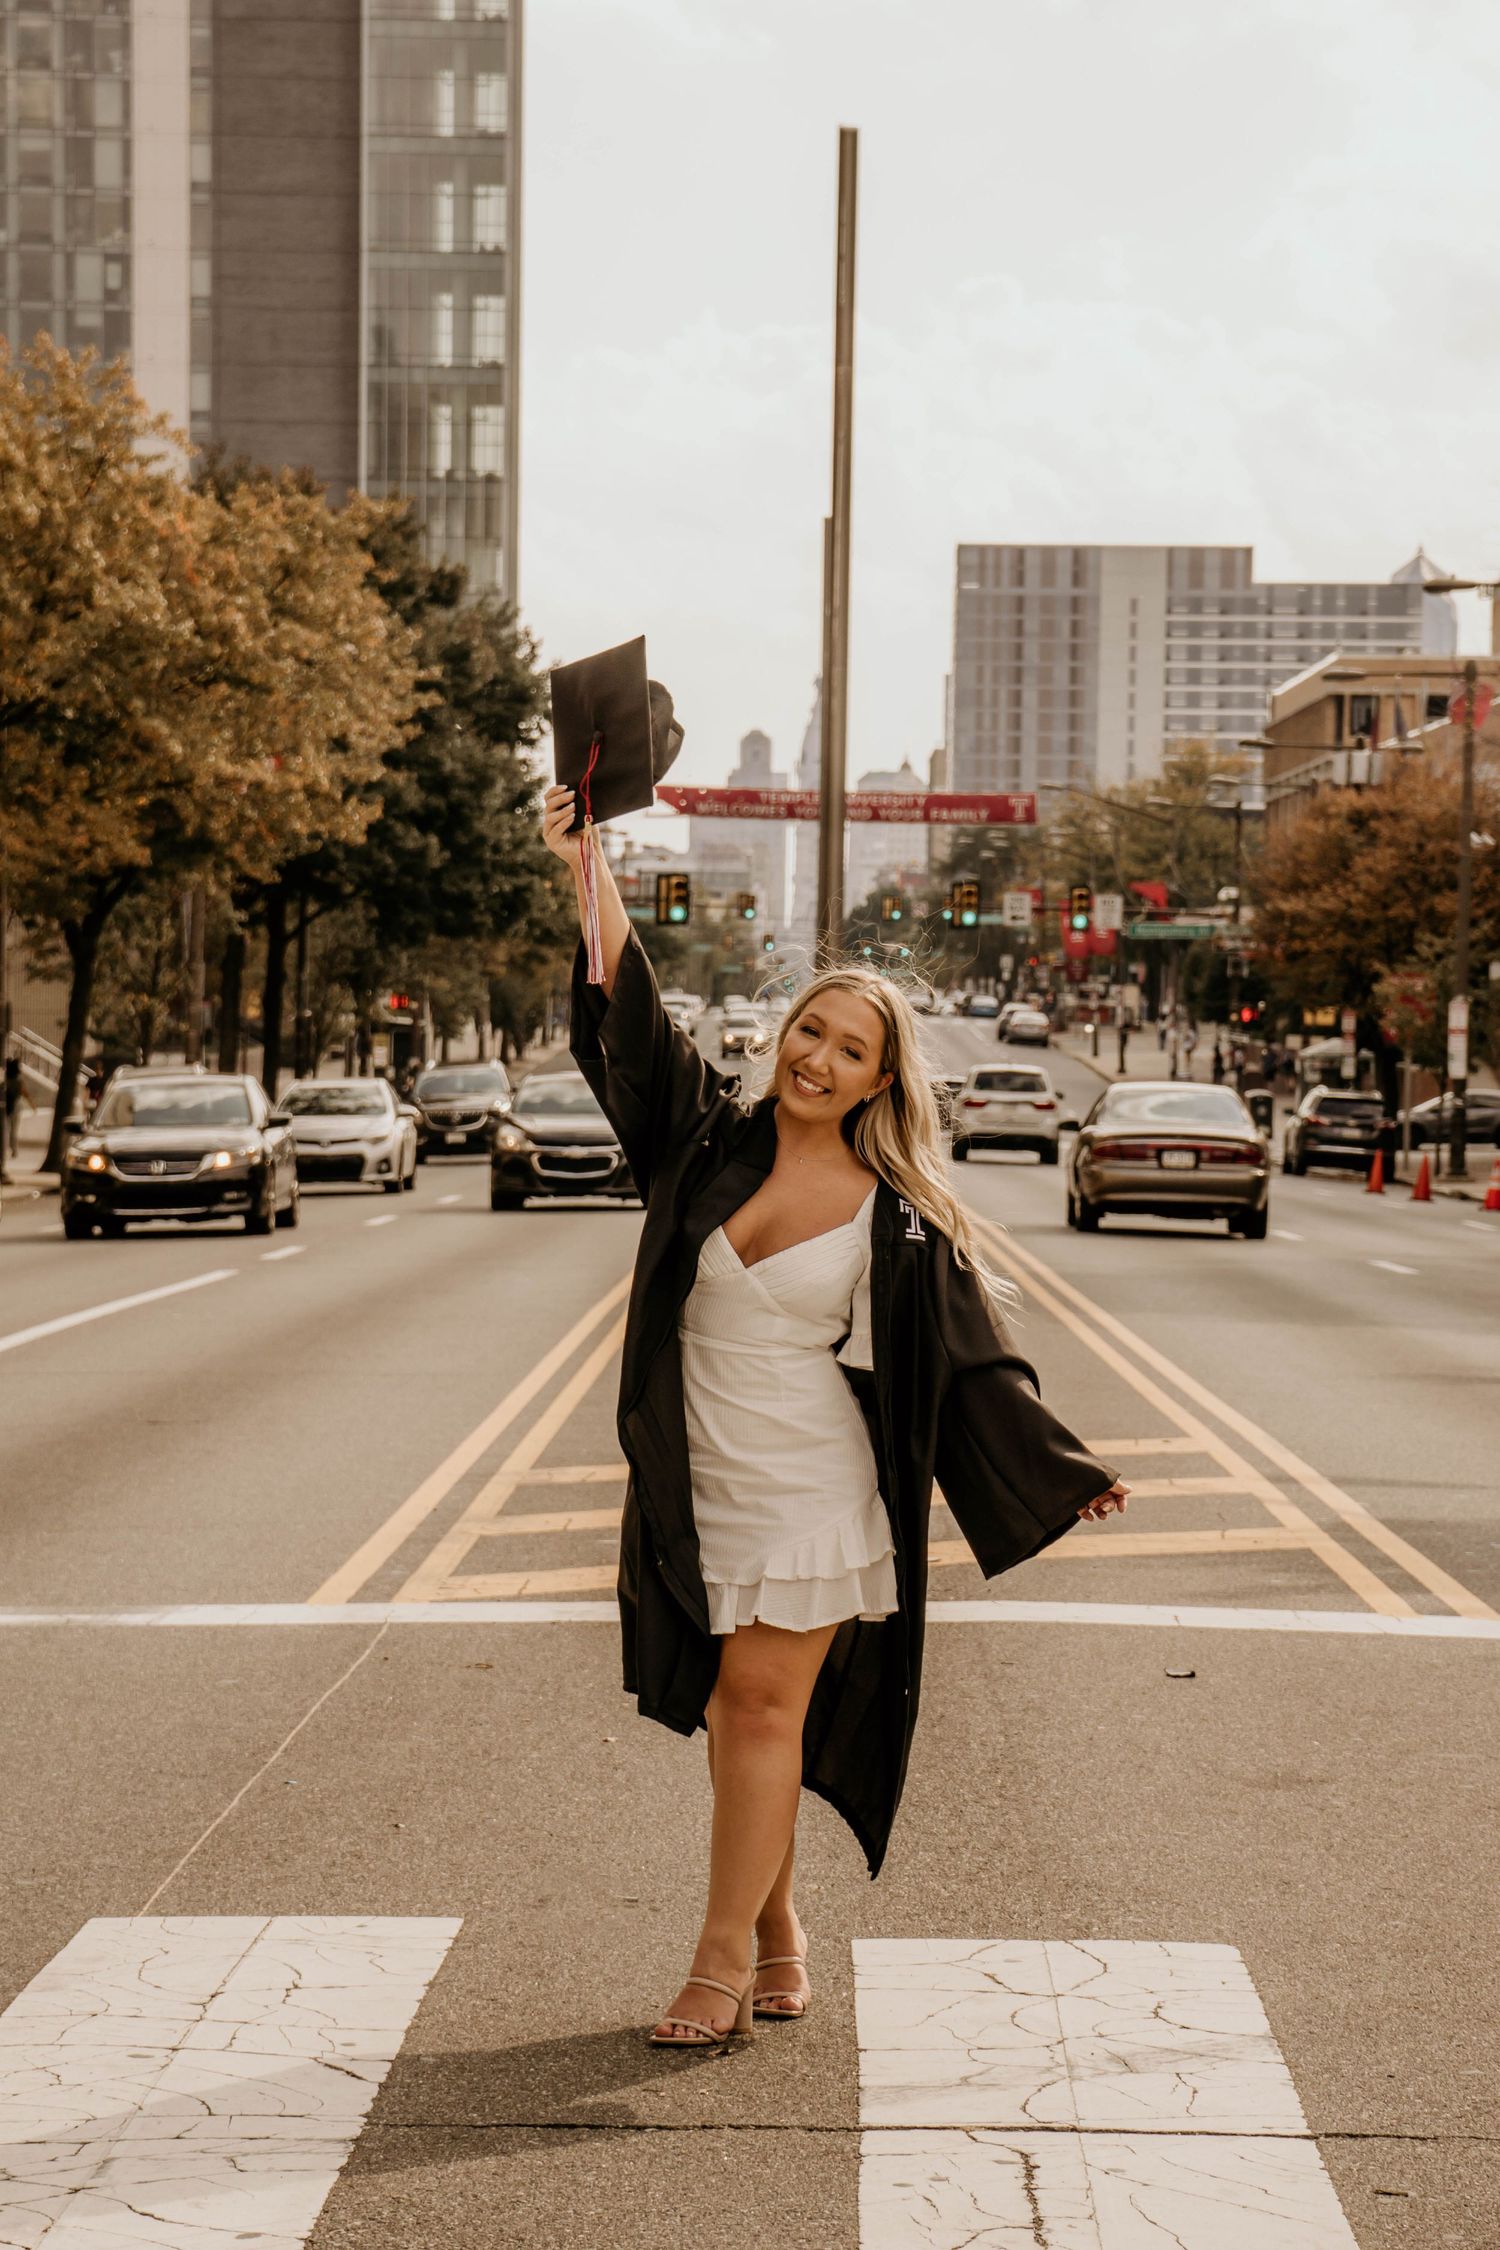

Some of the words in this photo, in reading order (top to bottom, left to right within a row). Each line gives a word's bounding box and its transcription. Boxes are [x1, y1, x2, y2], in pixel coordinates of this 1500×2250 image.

[695, 801, 787, 818] WELCOMES
[794, 806, 821, 819] YO
[846, 806, 873, 820] ND
[878, 807, 924, 821] YOUR
[929, 807, 990, 822] FAMILY
[845, 794, 927, 807] NIVERSITY
[1009, 797, 1030, 821] T
[898, 1198, 926, 1241] T
